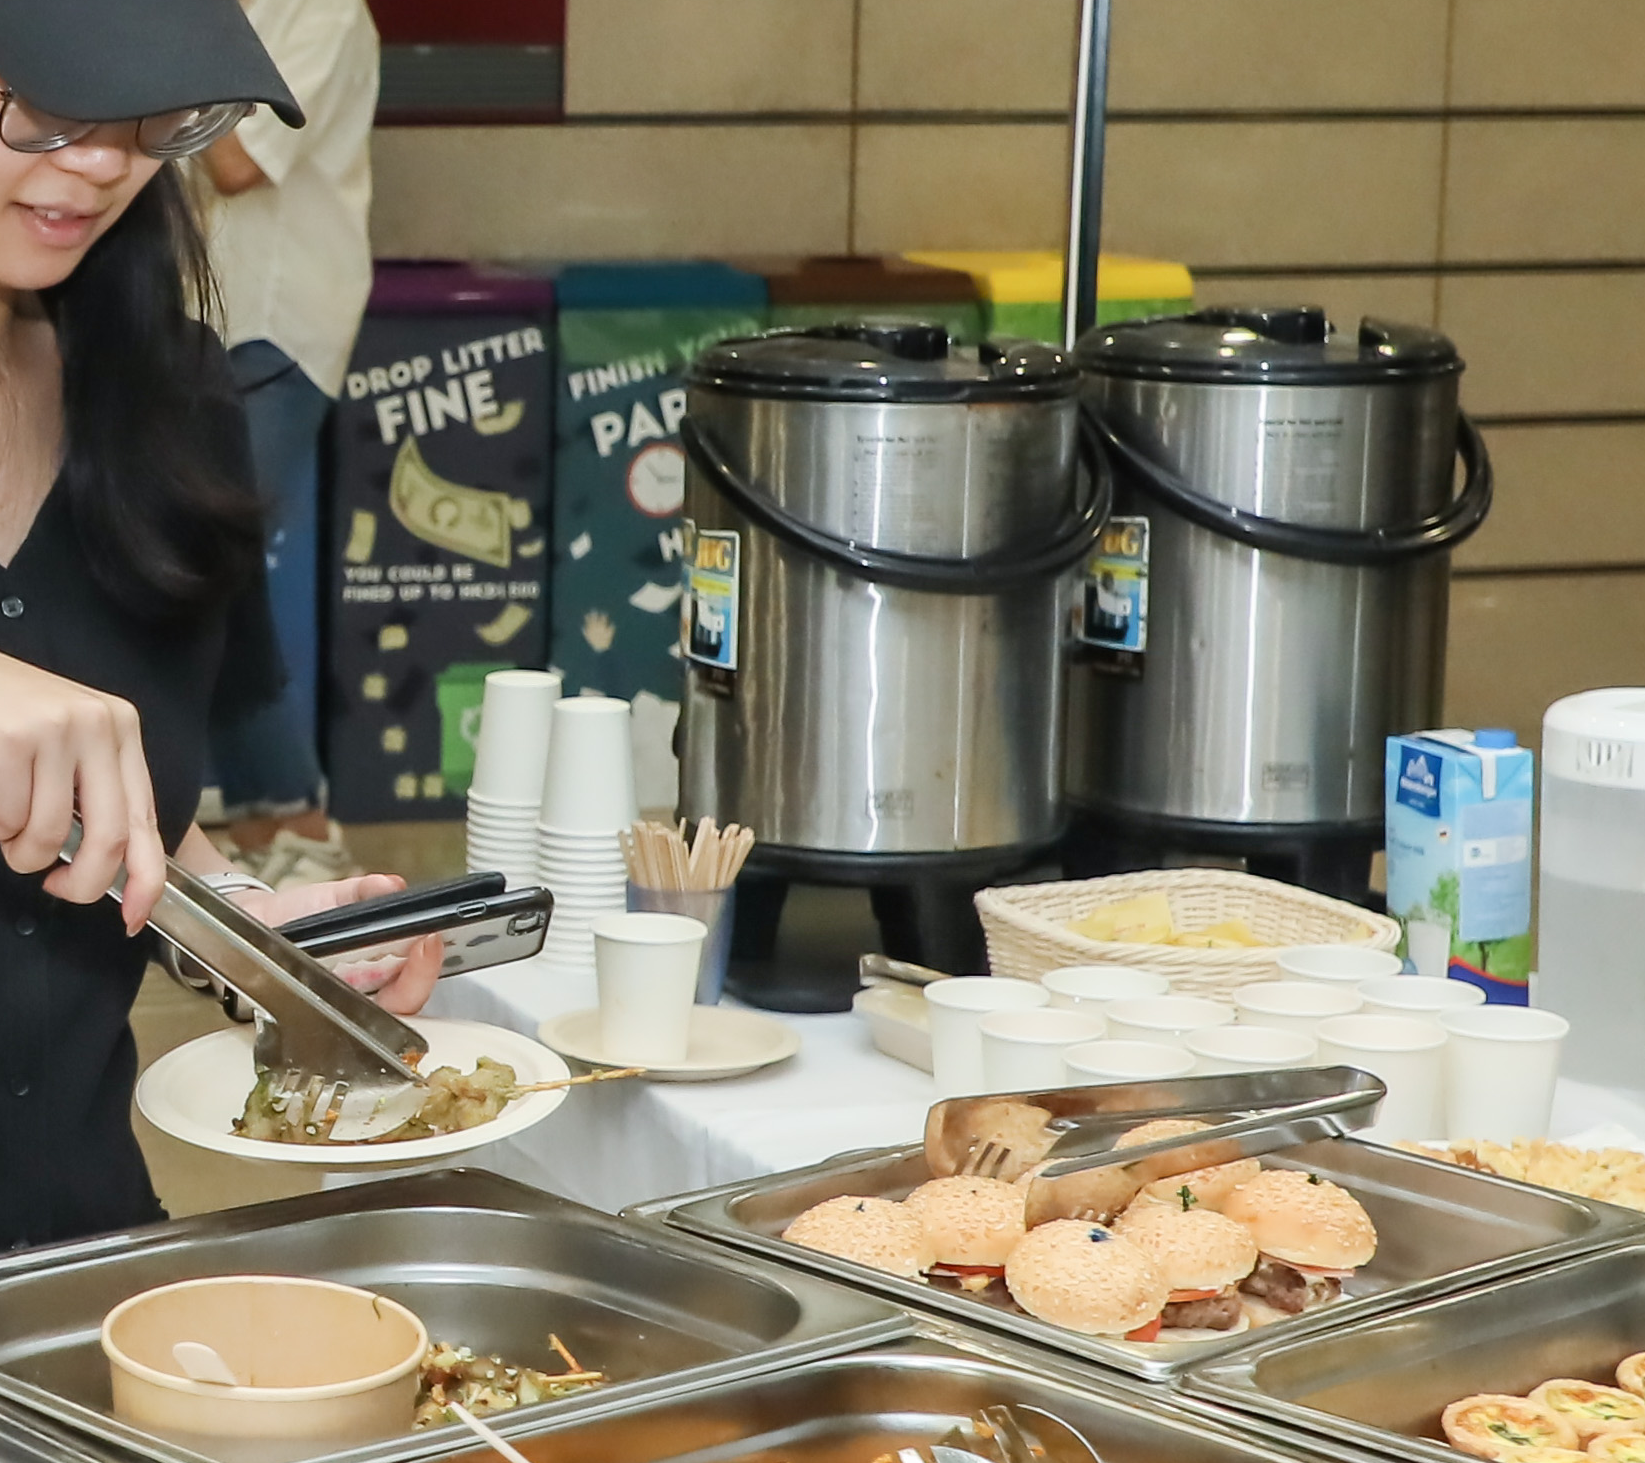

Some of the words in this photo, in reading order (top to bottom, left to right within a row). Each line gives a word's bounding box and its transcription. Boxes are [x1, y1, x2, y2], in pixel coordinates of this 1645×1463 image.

[346, 355, 433, 400] DROP
[441, 327, 545, 375] LITTER
[568, 350, 666, 402] FINISH
[375, 369, 499, 445] FINE
[342, 584, 395, 603] FINED
[398, 583, 424, 602] UP
[429, 583, 455, 601] TO
[344, 565, 383, 583] YOU
[387, 563, 447, 583] COULD
[451, 563, 474, 582] BE
